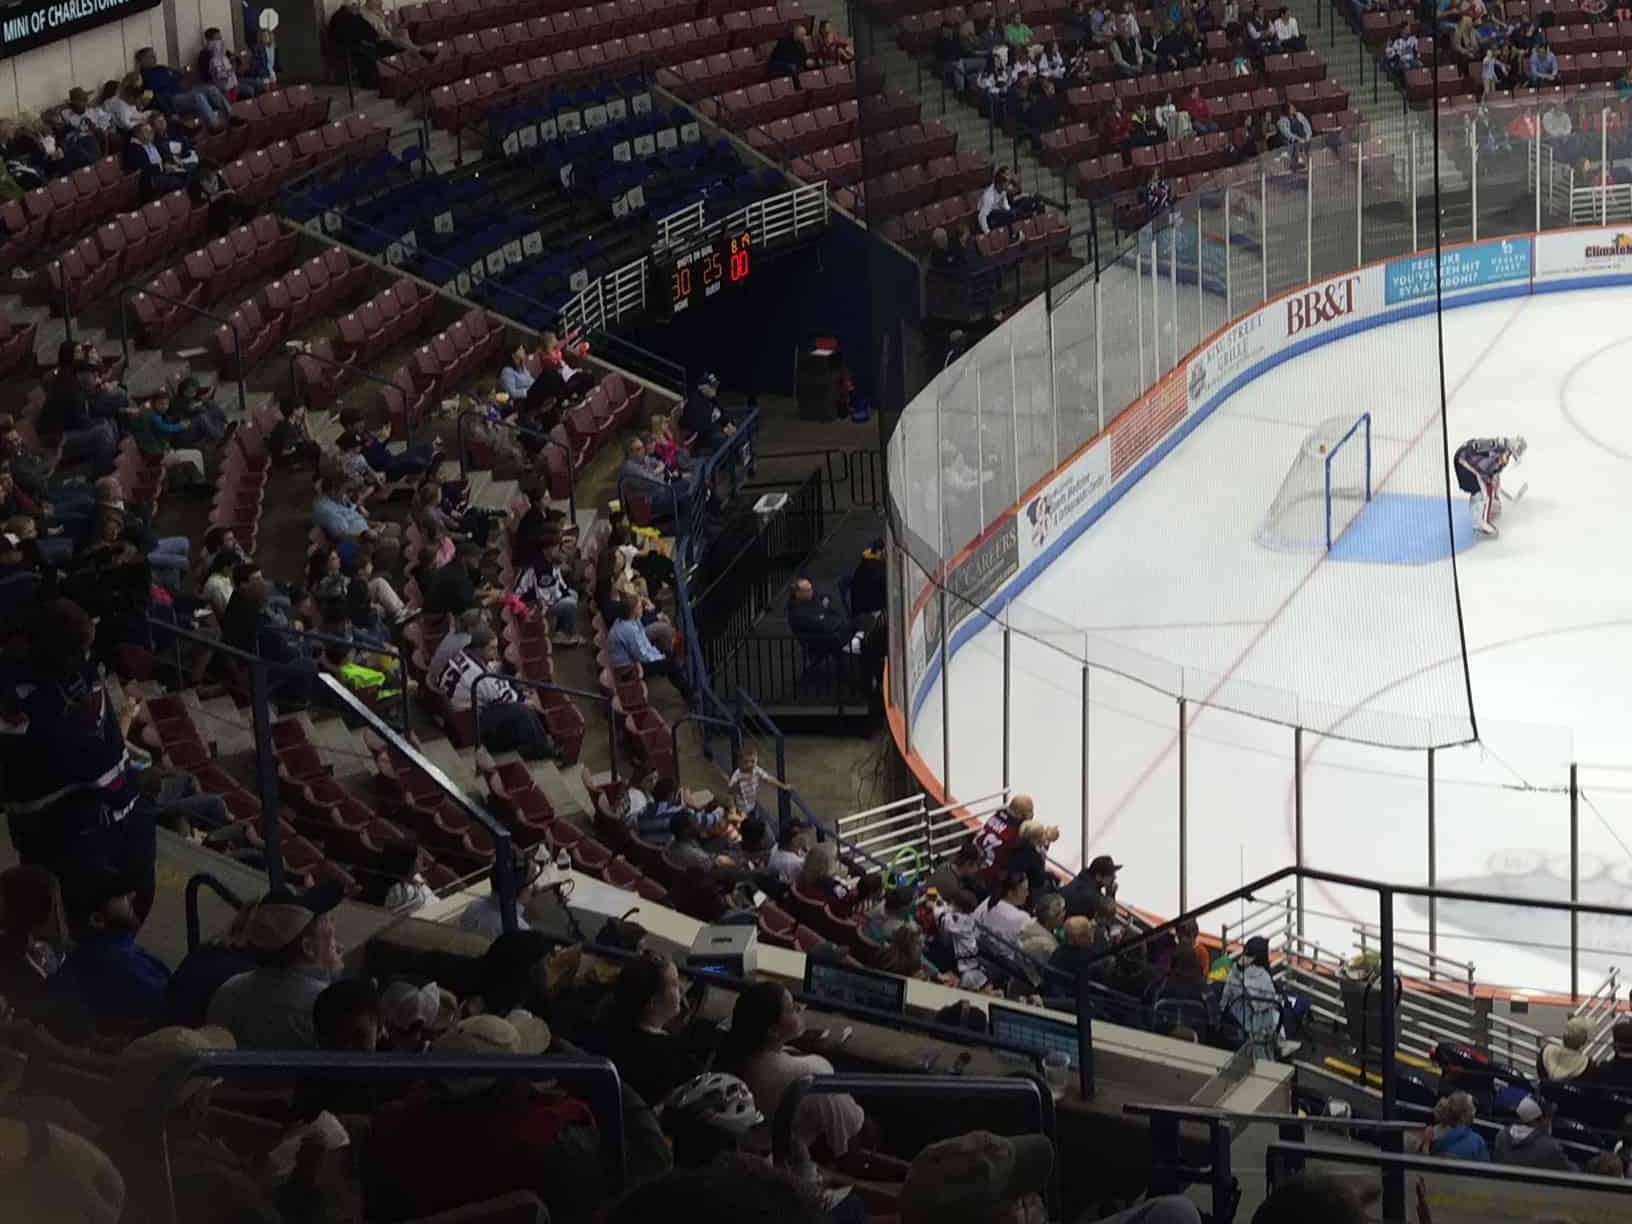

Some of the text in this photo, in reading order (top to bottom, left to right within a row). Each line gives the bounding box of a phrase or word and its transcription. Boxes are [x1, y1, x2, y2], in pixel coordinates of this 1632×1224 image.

[3, 14, 30, 43] MINI
[31, 9, 46, 33] OF
[730, 249, 749, 281] 00
[1286, 275, 1361, 336] BB&T
